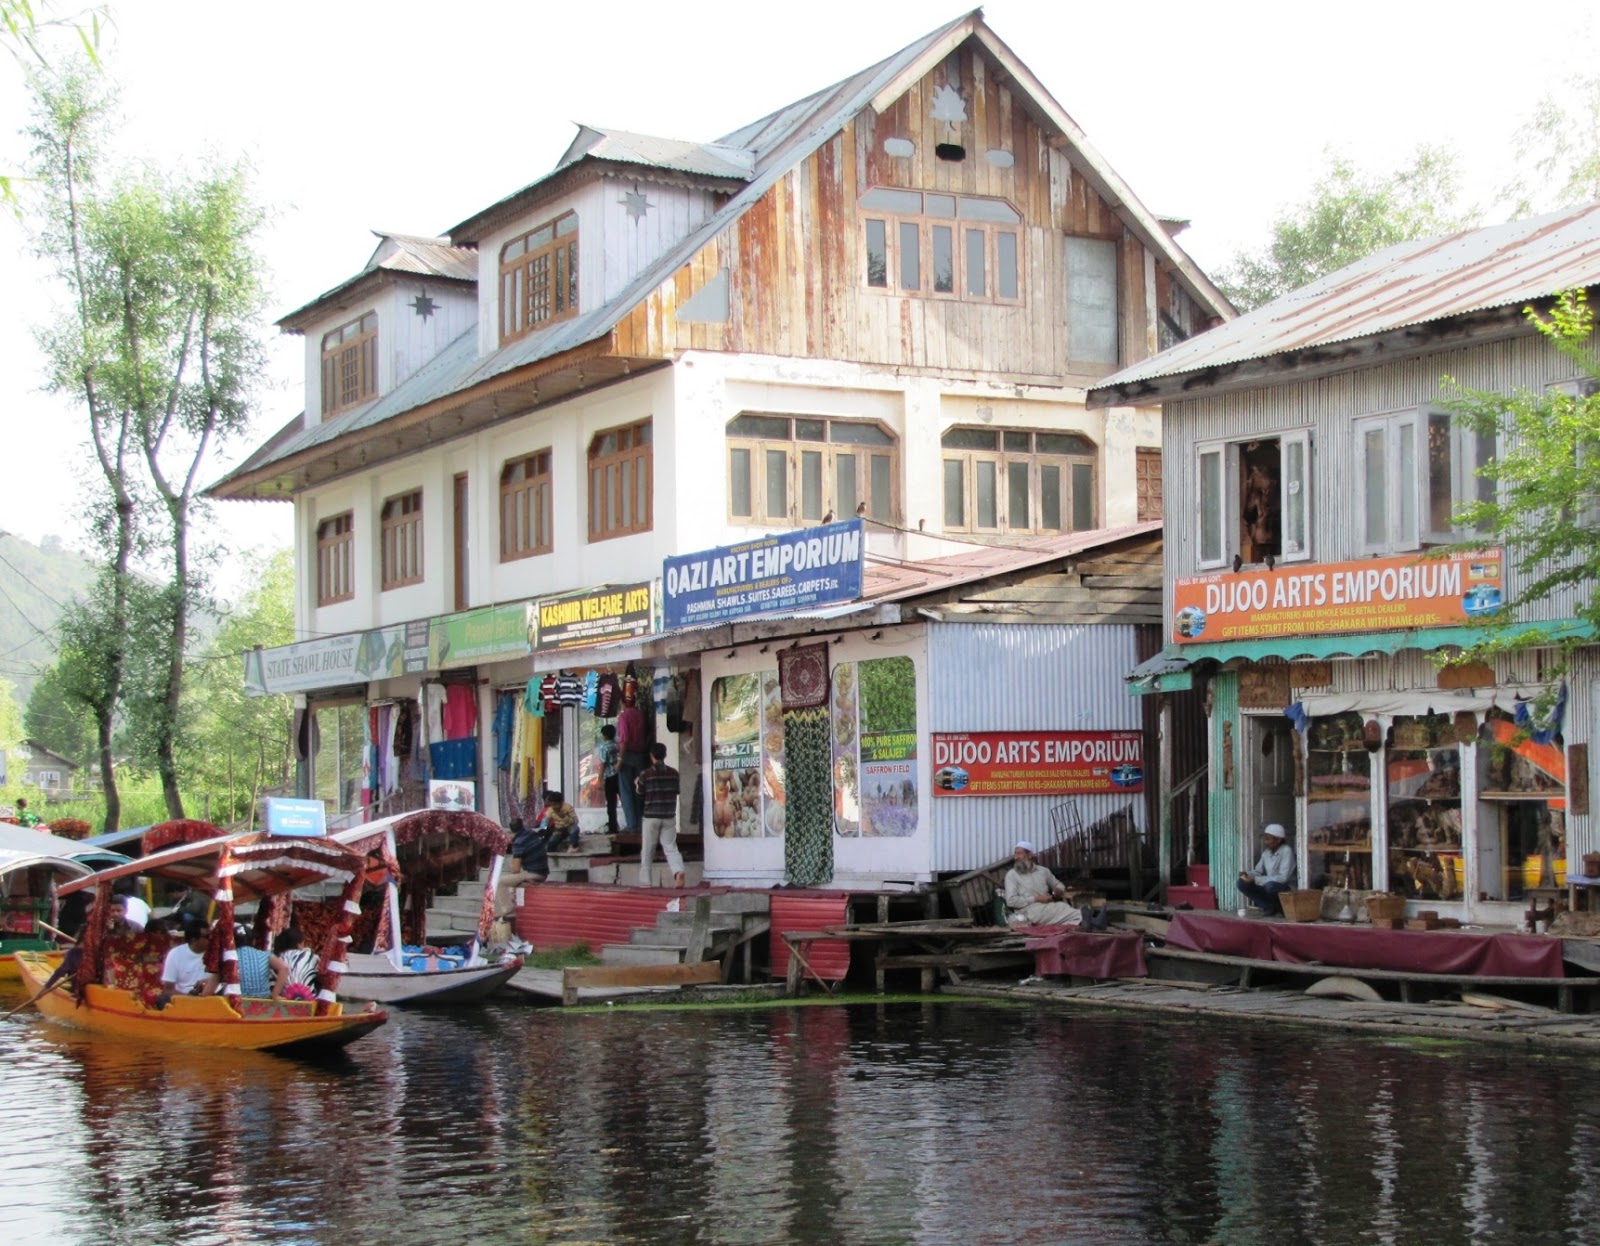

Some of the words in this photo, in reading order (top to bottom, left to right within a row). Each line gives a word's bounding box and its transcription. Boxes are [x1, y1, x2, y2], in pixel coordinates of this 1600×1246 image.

[667, 561, 708, 598] QAZI
[710, 553, 749, 587] ART
[752, 530, 860, 580] EMPORIUM
[1206, 579, 1268, 615] DIJOO
[1272, 573, 1327, 608] ARTS
[1332, 563, 1461, 605] EMPORIUM
[541, 600, 581, 628] KASHMIR
[582, 593, 623, 620] WELFARE
[625, 588, 649, 613] ARTS
[686, 599, 715, 614] PASHMINA
[1251, 611, 1301, 622] MANUFACTURERS
[1302, 610, 1316, 618] AND
[1317, 607, 1339, 617] WHOLE
[1340, 607, 1355, 616] SALE
[1355, 605, 1377, 615] RETAIL
[1378, 603, 1406, 614] DEALERS
[1222, 626, 1239, 637] GIFT
[1239, 625, 1260, 636] ITEMS
[1260, 623, 1281, 634] START
[1282, 621, 1304, 633] FROM
[1367, 617, 1388, 627] WITH
[1389, 615, 1413, 626] NAME
[1414, 615, 1425, 625] 60
[267, 658, 292, 679] STATE
[292, 653, 322, 676] SHAWL
[322, 647, 354, 671] HOUSE
[876, 735, 892, 747] PURE
[935, 741, 992, 765] DIJOO
[995, 740, 1040, 764] ARTS
[1044, 740, 1140, 763] EMPORIUM
[725, 758, 740, 769] FRUIT
[741, 757, 761, 768] HOUSE
[865, 765, 892, 774] SAFFRON
[893, 764, 910, 773] FIELD
[970, 782, 981, 790] GIFT
[982, 782, 998, 790] ITEMS
[998, 781, 1012, 789] START
[1013, 781, 1028, 789] FROM
[1066, 780, 1079, 789] WITH
[1080, 780, 1095, 788] NAME
